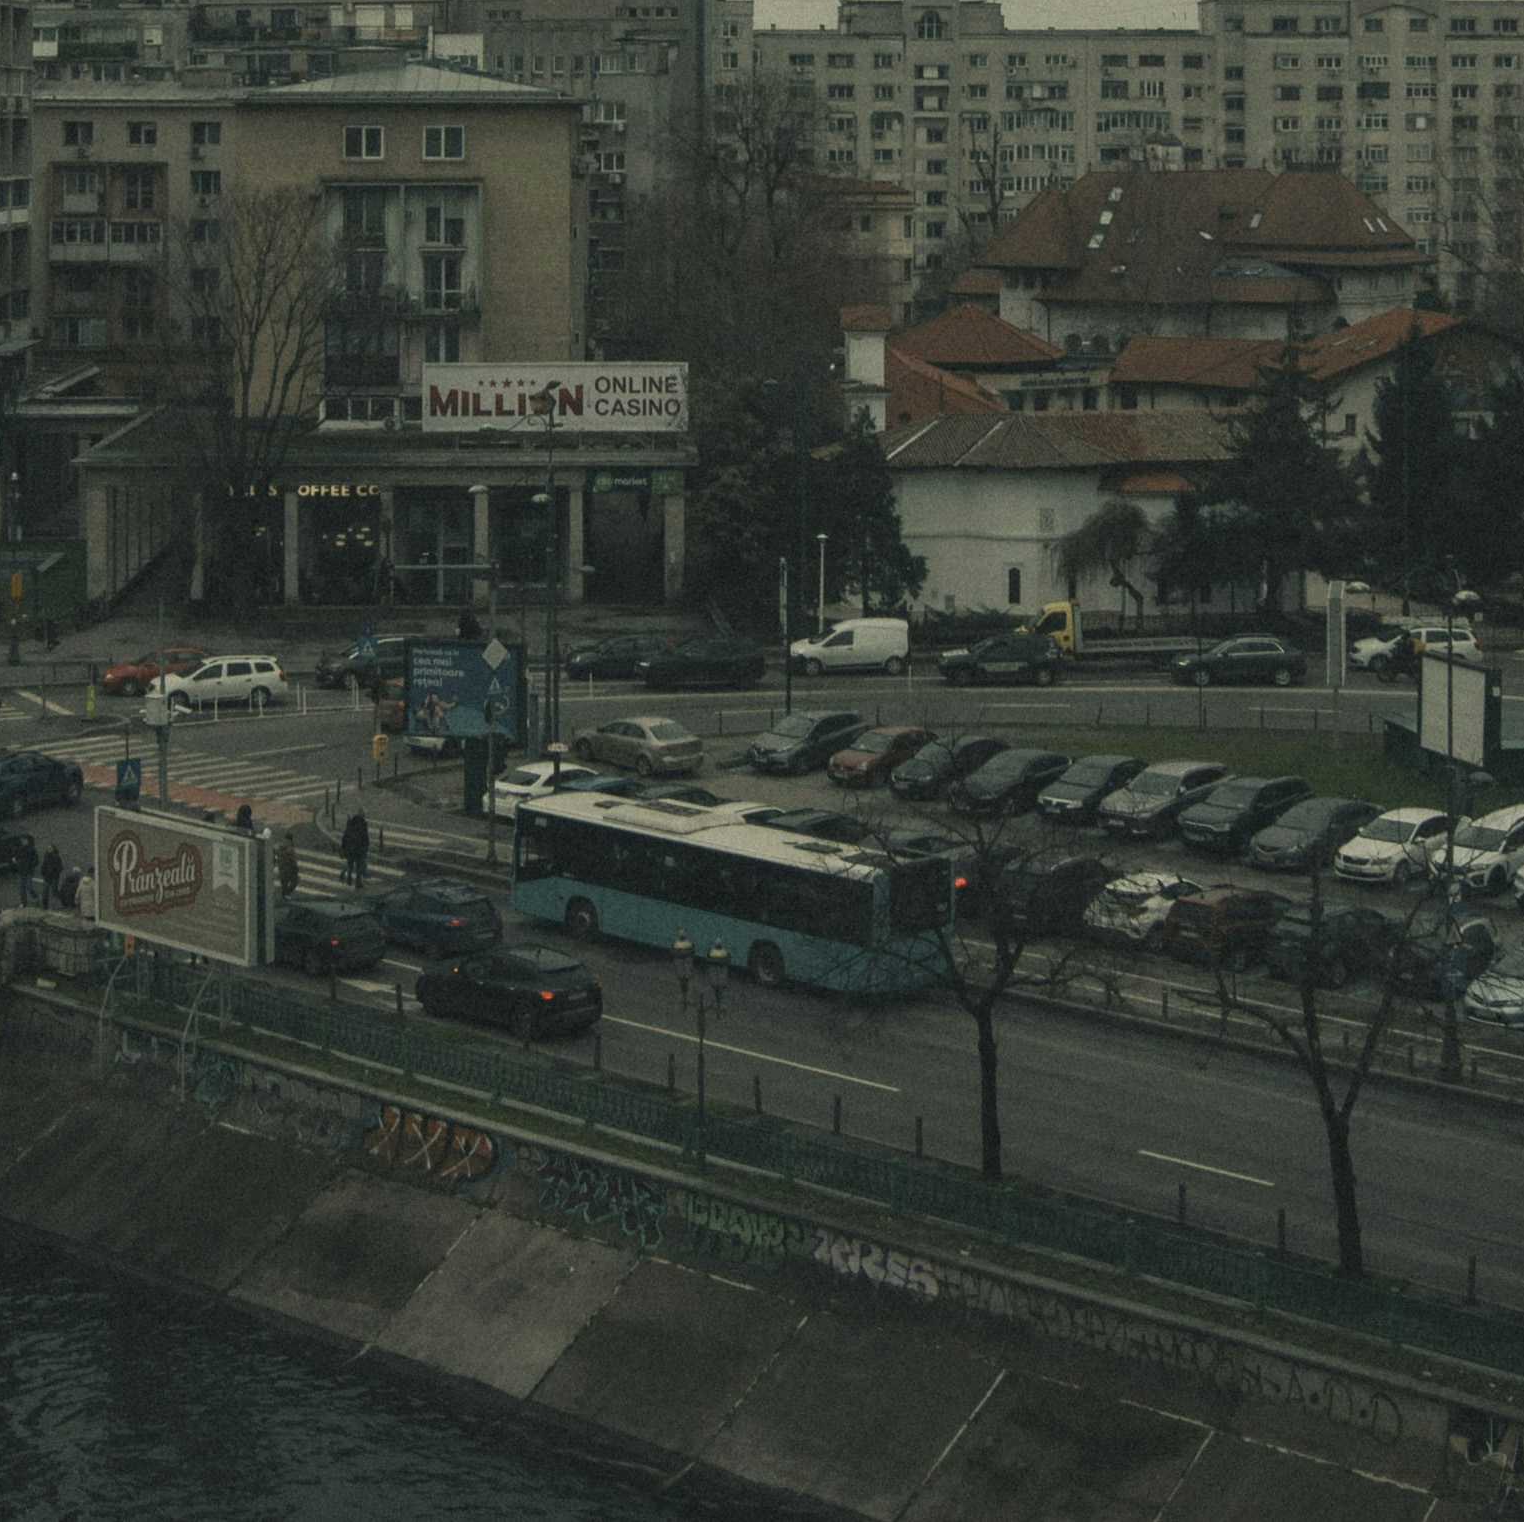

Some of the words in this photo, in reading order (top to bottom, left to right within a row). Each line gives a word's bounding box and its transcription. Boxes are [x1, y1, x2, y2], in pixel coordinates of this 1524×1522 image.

[594, 376, 679, 394] ONLINE
[594, 398, 681, 417] CASINO
[614, 476, 648, 486] market
[296, 484, 351, 497] OFFEE
[112, 840, 197, 905] Prânzeală
